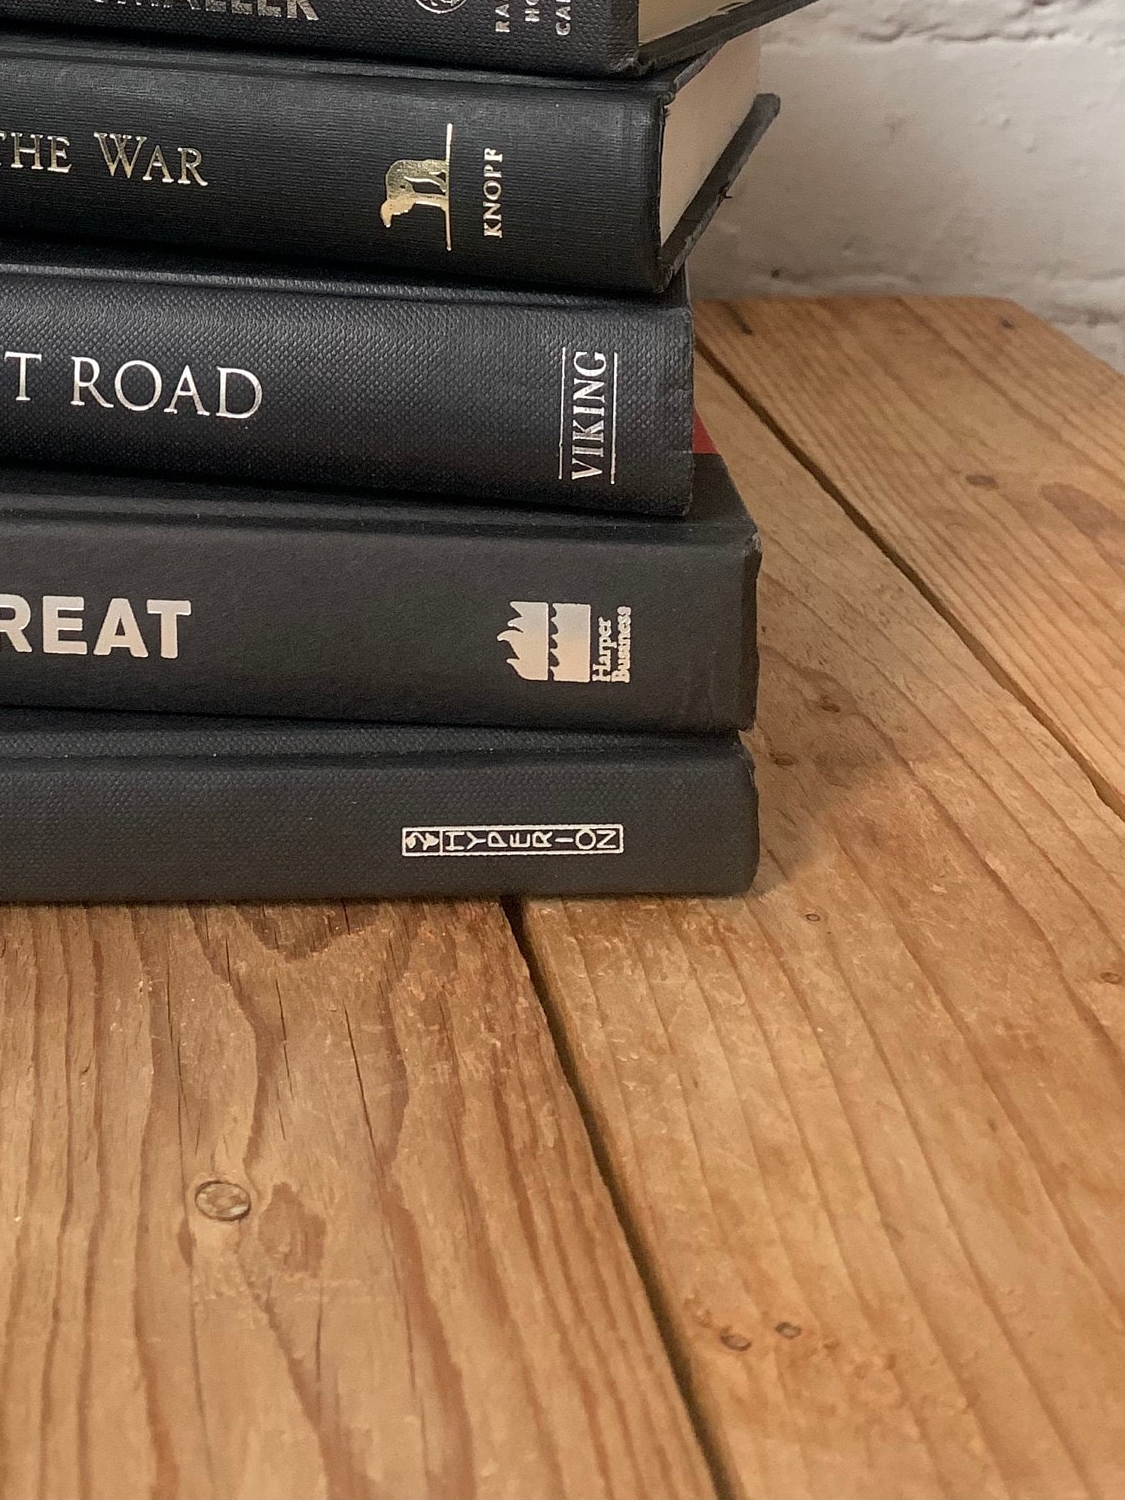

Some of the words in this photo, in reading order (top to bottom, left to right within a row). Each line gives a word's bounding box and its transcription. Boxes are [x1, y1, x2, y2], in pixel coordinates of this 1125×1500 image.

[94, 131, 208, 186] WAR
[483, 147, 503, 238] KNOPF
[70, 356, 263, 419] ROAD
[571, 351, 607, 480] VIKING
[592, 617, 617, 682] Harper
[611, 606, 632, 683] Business
[445, 828, 617, 851] HYPERION
